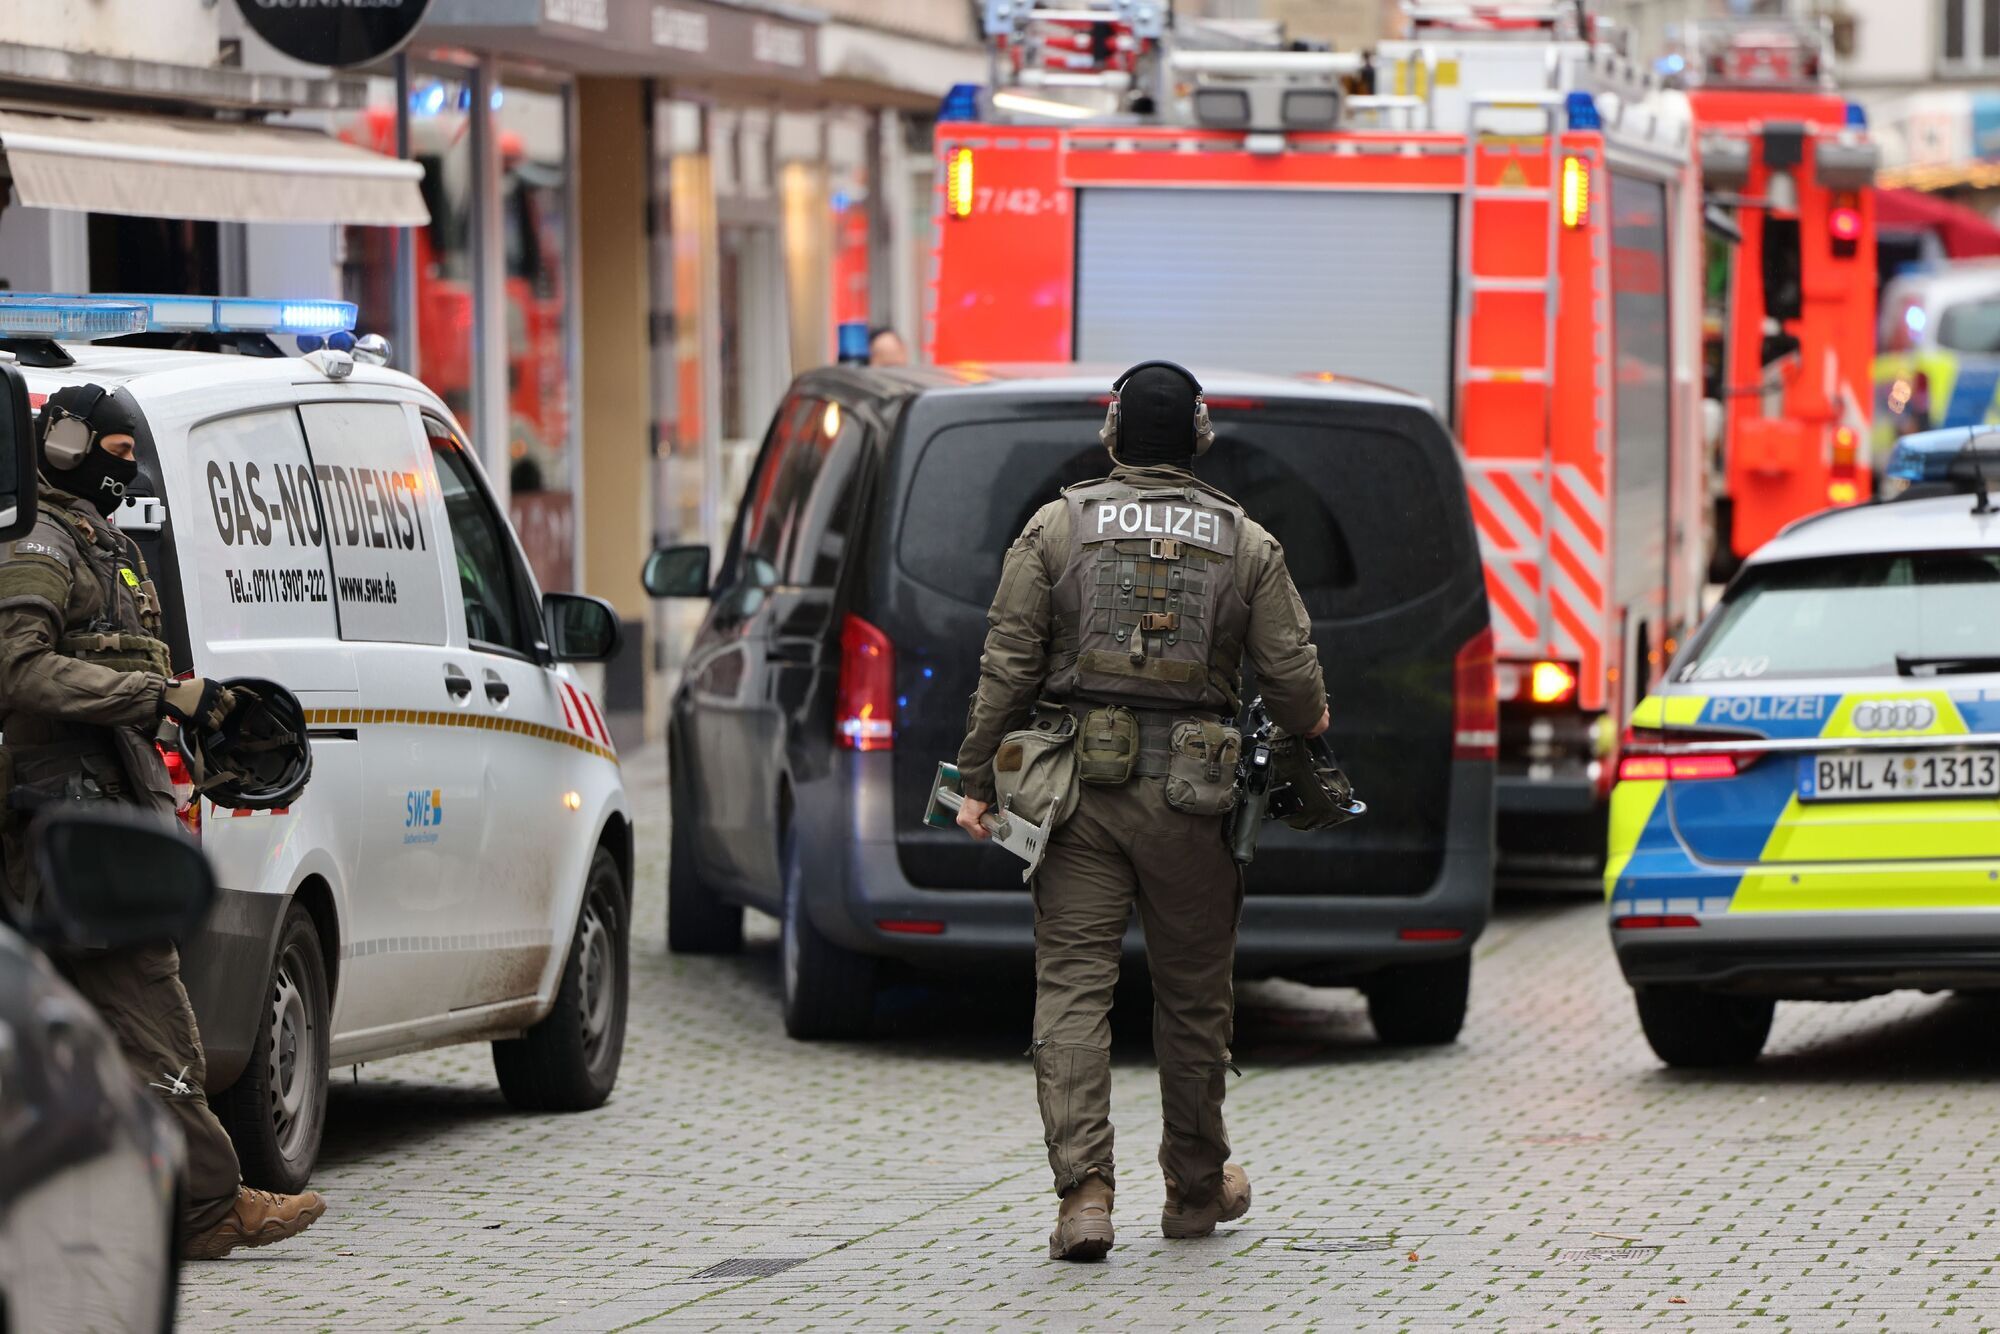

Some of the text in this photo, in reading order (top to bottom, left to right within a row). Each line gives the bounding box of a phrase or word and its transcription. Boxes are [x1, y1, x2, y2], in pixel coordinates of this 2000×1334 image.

[207, 460, 426, 551] GAS-NOTDIENST
[1097, 503, 1219, 545] POLIZEI
[225, 569, 397, 604] Tel.: 0711 3907-222 www.swe.de
[1710, 695, 1825, 722] POLIZEI
[1818, 759, 1873, 791] BWL
[1882, 758, 1898, 789] 4
[1922, 756, 1995, 788] 1313
[406, 789, 431, 827] SWE
